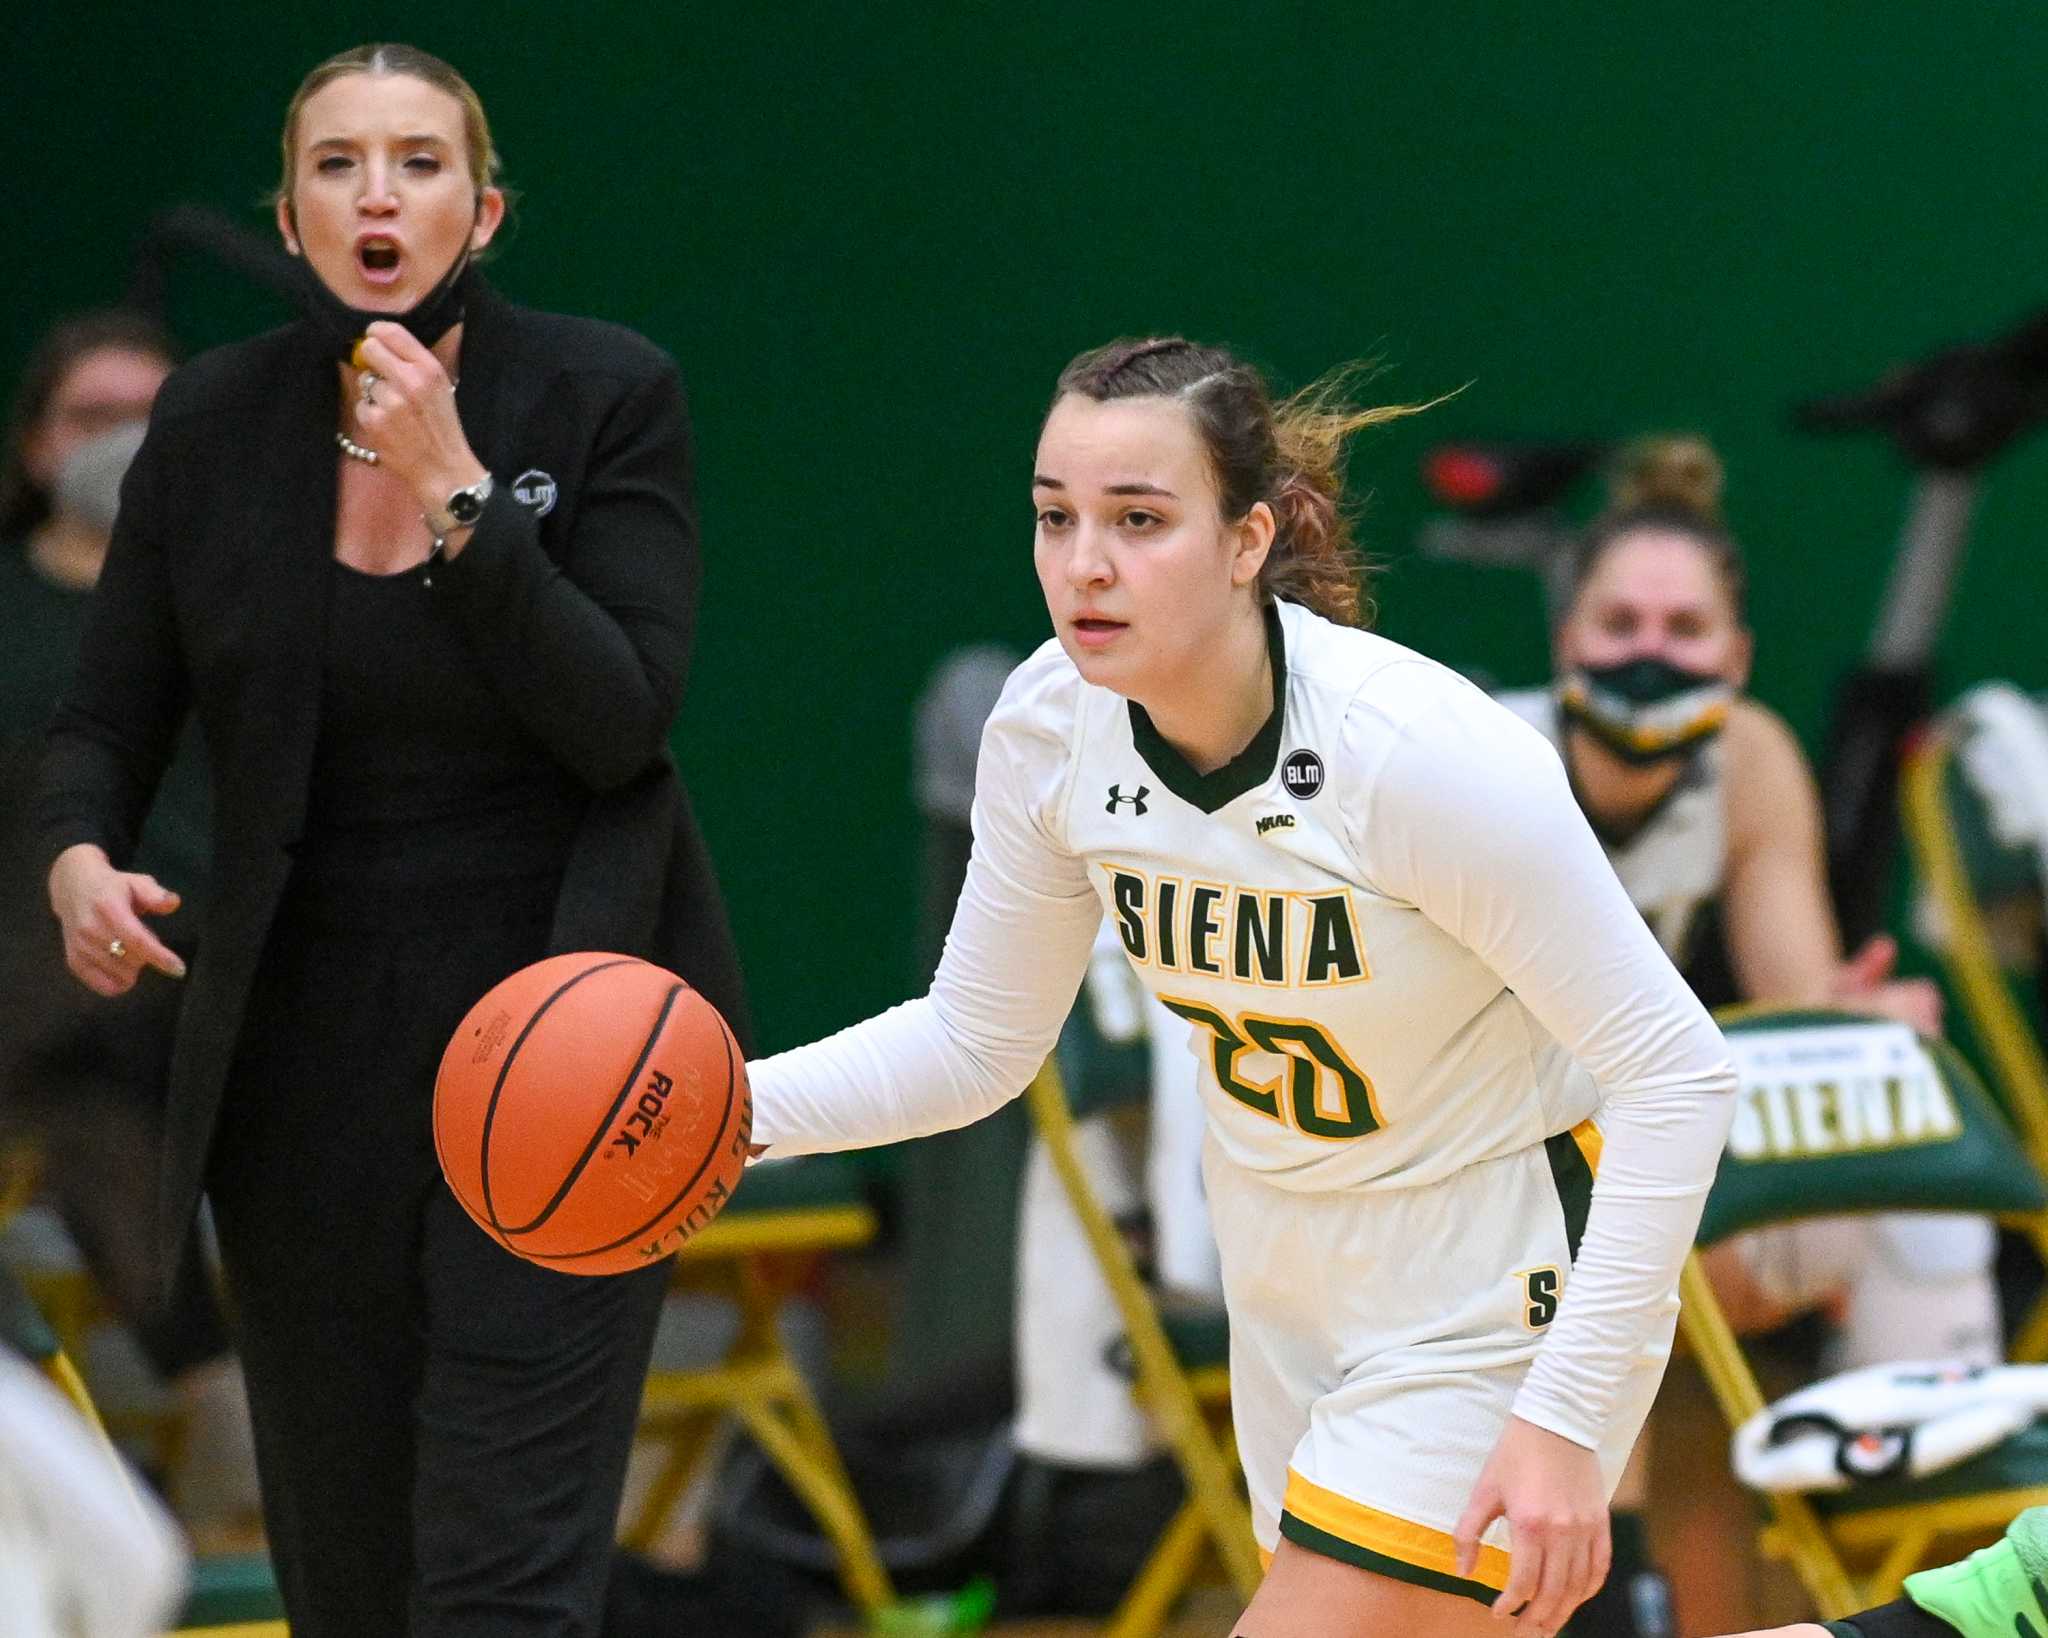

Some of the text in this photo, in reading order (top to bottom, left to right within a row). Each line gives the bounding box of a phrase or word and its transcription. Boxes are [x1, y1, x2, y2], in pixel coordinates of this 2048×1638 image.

[1286, 765, 1320, 784] BLM
[1255, 814, 1296, 836] MAAC
[1104, 866, 1369, 987] SIENA
[1158, 993, 1388, 1142] 20
[612, 1070, 673, 1160] ROCK
[1521, 1265, 1562, 1334] S
